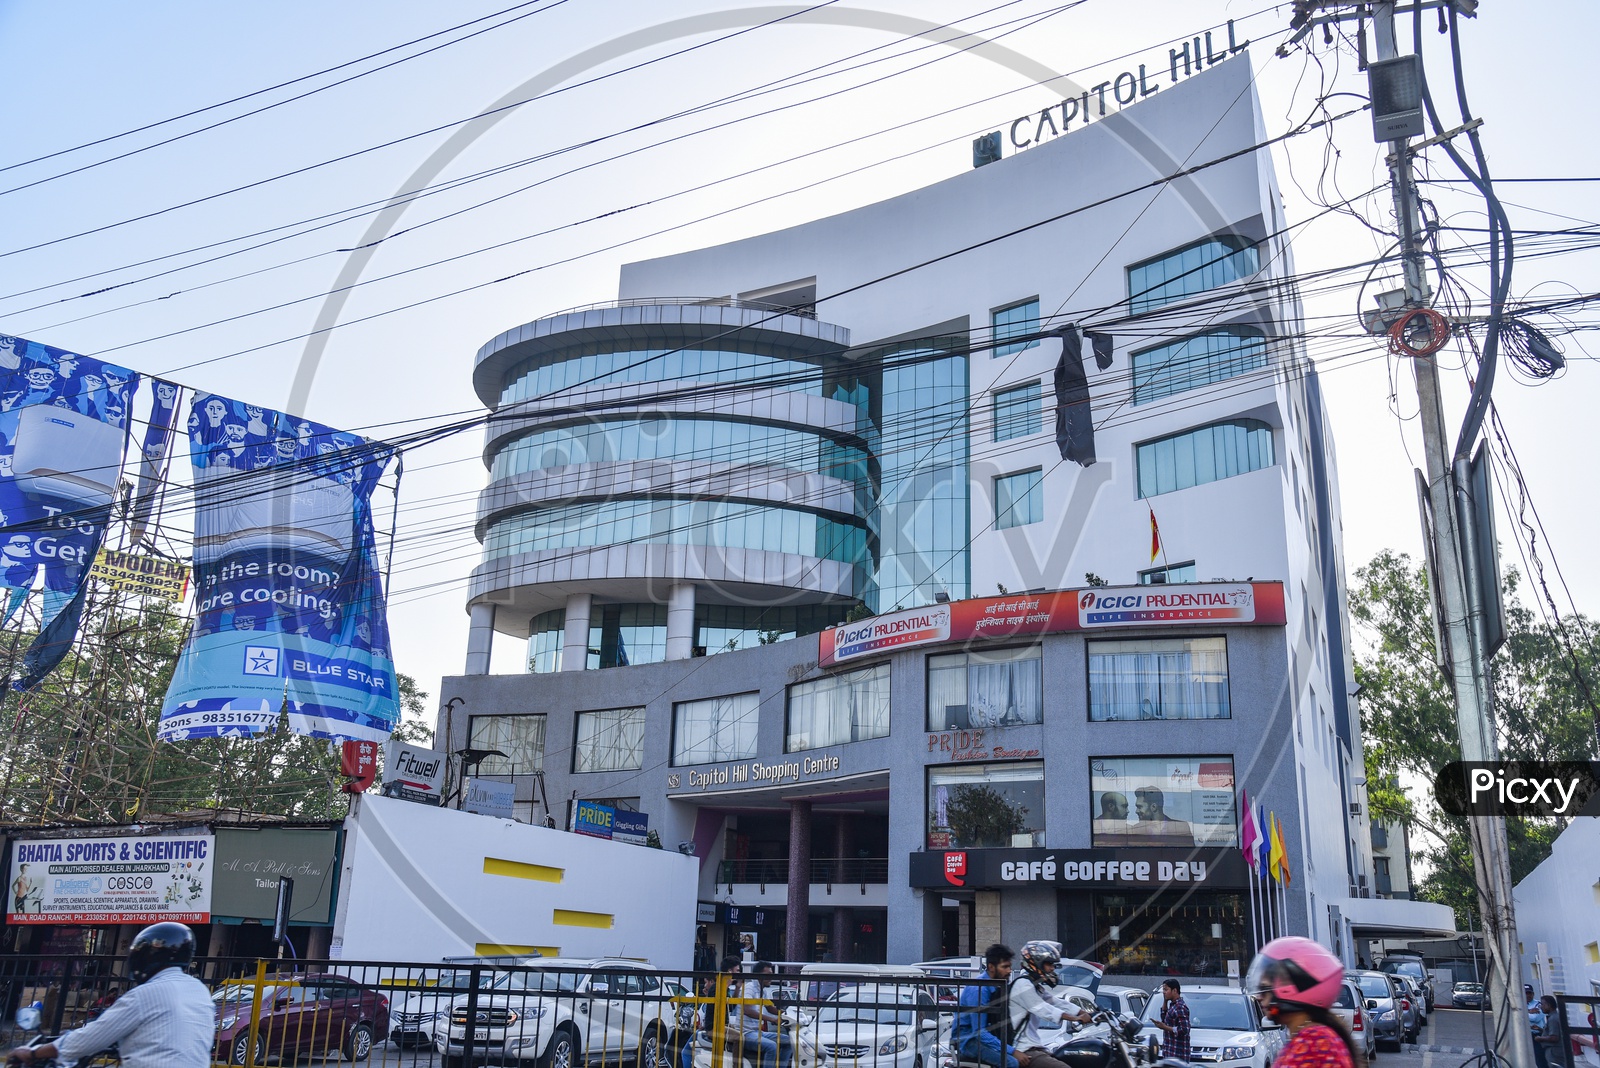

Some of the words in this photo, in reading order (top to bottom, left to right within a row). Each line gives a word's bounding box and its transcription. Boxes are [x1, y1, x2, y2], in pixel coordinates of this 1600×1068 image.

[1010, 64, 1160, 148] CAPITOL
[1169, 19, 1251, 82] HILL
[1387, 123, 1408, 131] SURYA
[42, 505, 95, 536] Too
[33, 536, 87, 566] Get
[104, 551, 186, 580] MODEM
[221, 561, 260, 581] the
[267, 561, 340, 590] room?
[1095, 595, 1142, 609] ICICI
[1146, 593, 1230, 607] PRUDENTIAL
[1133, 611, 1212, 619] INSURANCE
[844, 627, 873, 644] ICICI
[874, 615, 932, 637] PRUDENTIAL
[842, 646, 859, 655] LIFE
[865, 634, 919, 648] INSURANCE
[293, 660, 342, 677] BLUE
[347, 668, 385, 689] STAR
[163, 717, 192, 730] Sons
[928, 729, 985, 752] PRIDE
[395, 750, 441, 779] Fitwell
[951, 748, 988, 761] Fashion
[993, 746, 1040, 760] Boutique
[689, 767, 729, 789] Capitol
[732, 764, 748, 783] Hill
[752, 761, 800, 783] Shopping
[803, 754, 839, 774] Centre
[17, 844, 63, 863] BHATIA
[66, 842, 116, 862] SPORTS
[119, 842, 130, 861] &
[133, 839, 208, 861] SCIENTIFIC
[64, 865, 101, 873] AUTHORISED
[101, 865, 124, 873] DEALER
[131, 864, 169, 872] JHARKHAND
[297, 861, 321, 876] Sons
[107, 876, 153, 890] COSCO
[147, 913, 157, 921] (R)
